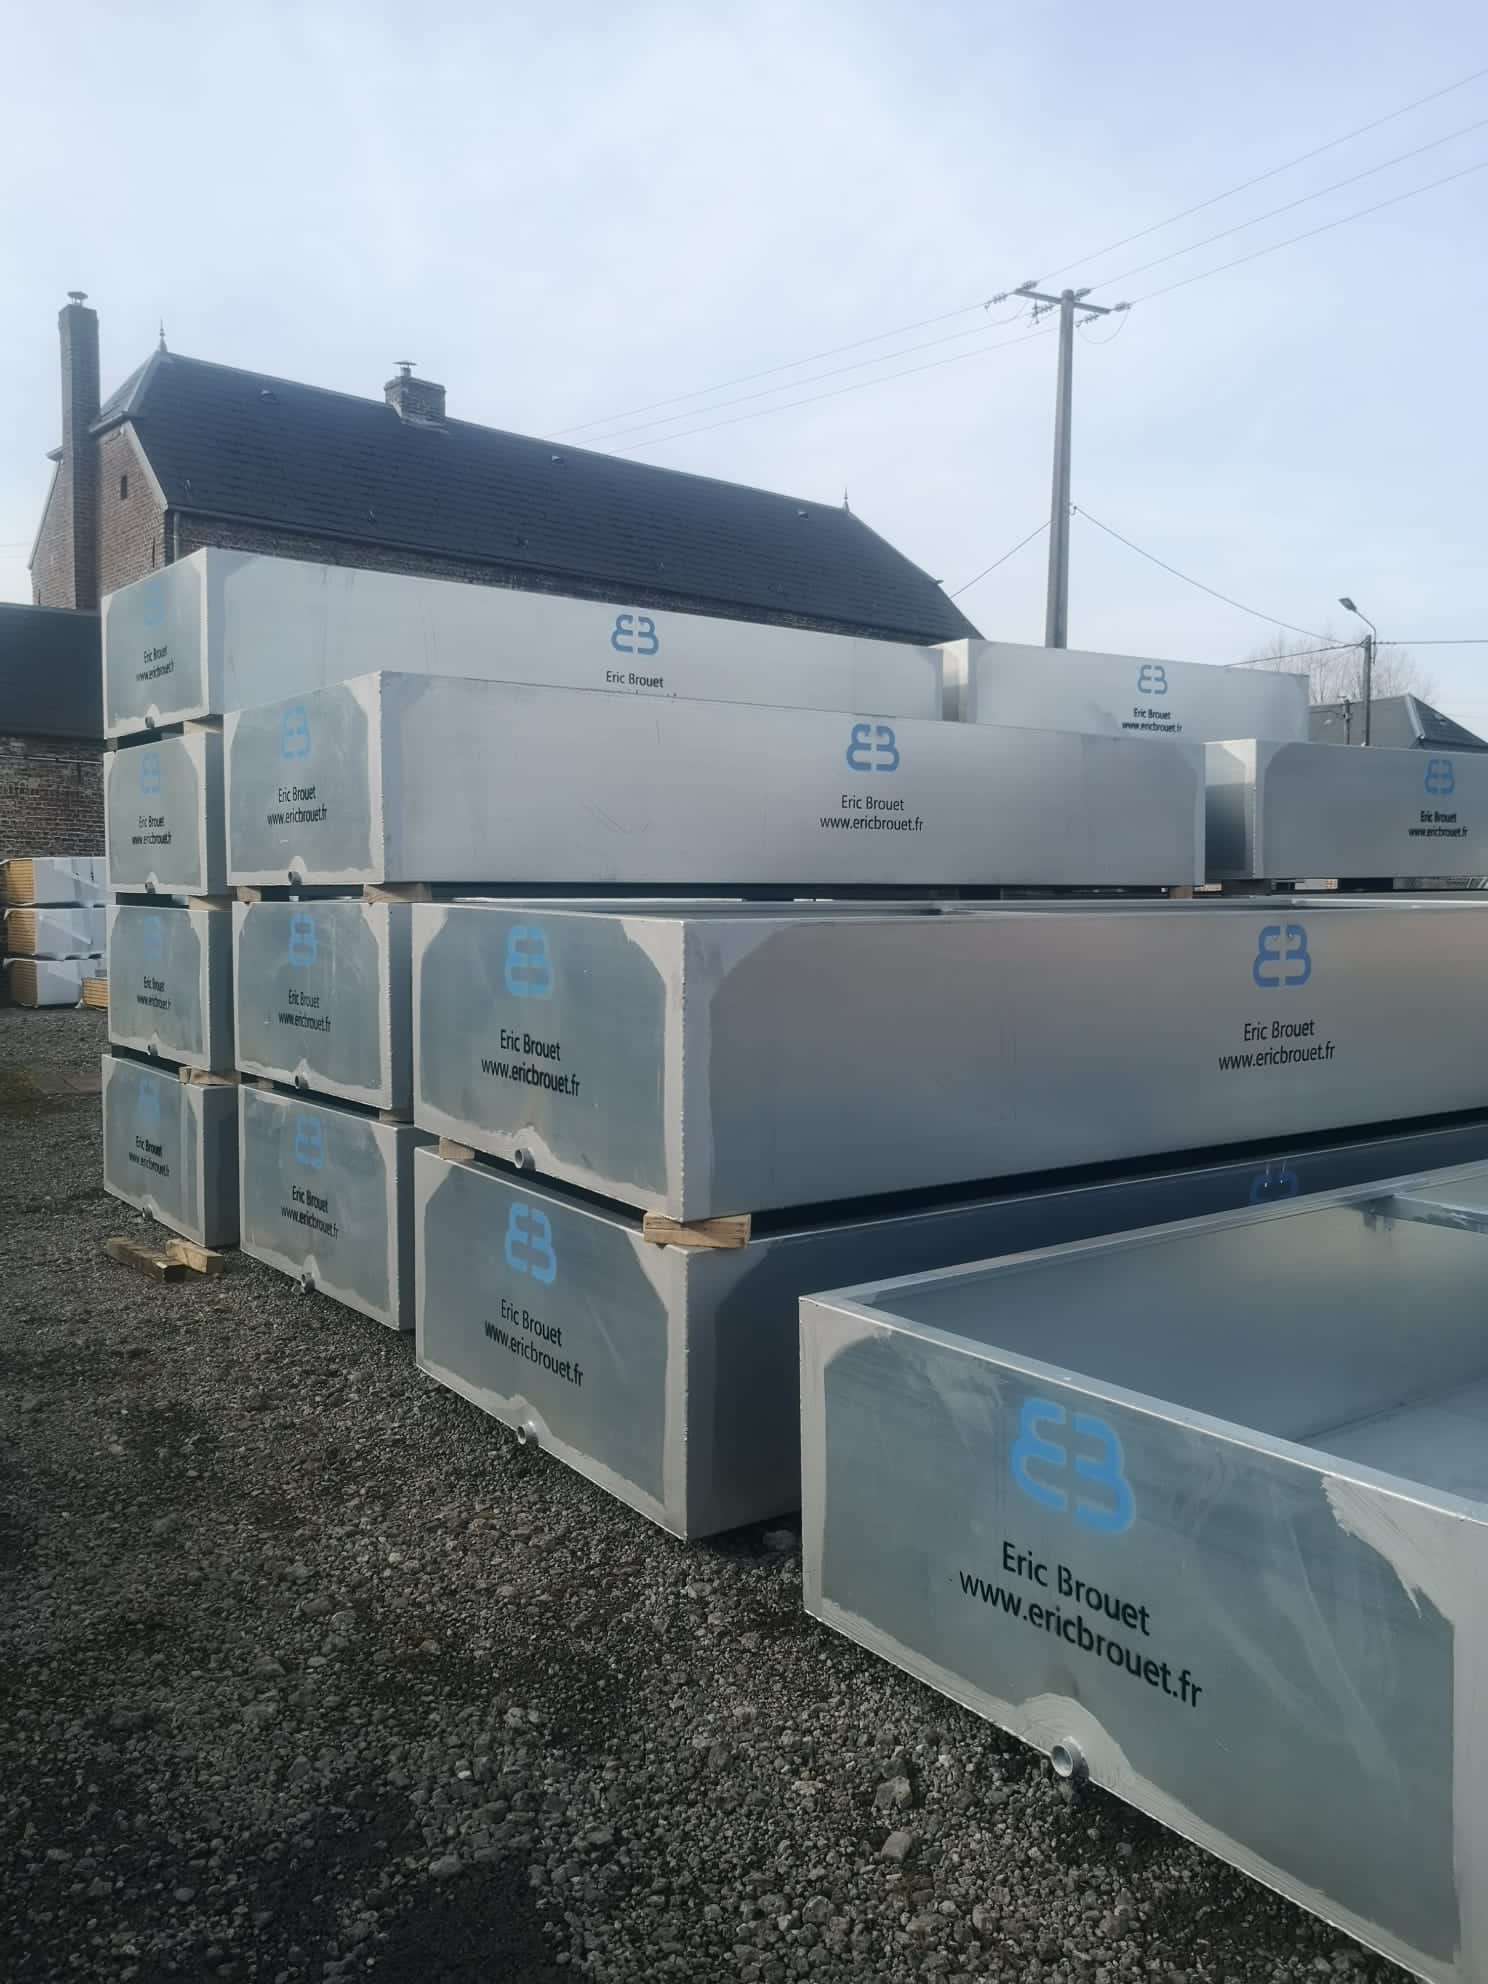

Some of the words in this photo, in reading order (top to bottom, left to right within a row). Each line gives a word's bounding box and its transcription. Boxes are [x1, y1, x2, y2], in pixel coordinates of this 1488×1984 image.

[143, 649, 153, 664] Eric
[153, 645, 168, 661] Brouet
[606, 670, 625, 686] Eric
[628, 673, 664, 689] Brouet
[1133, 707, 1147, 719] Eric
[1148, 708, 1171, 720] Brouet
[1122, 719, 1182, 734] www.ericbrouet.fr
[278, 787, 291, 803] Eric
[292, 784, 316, 801] Brouet
[841, 795, 863, 810] Eric
[865, 796, 905, 812] Brouet
[148, 814, 165, 828] Brouet
[267, 804, 327, 825] www.ericbrouet.fr
[820, 816, 924, 832] www.ericbrouet.fr
[1420, 811, 1433, 823] Eric
[1434, 811, 1457, 824] Brouet
[1408, 825, 1468, 838] www.ericbrouet.fr
[288, 989, 300, 1004] Eric
[301, 991, 320, 1009] Brouet
[278, 1011, 331, 1033] www.ericbrouet.fr
[1244, 1022, 1268, 1042] Eric
[1272, 1018, 1315, 1039] Brouet
[500, 1028, 520, 1053] Eric
[523, 1034, 561, 1062] Brouet
[1218, 1041, 1335, 1071] www.ericbrouet.fr
[481, 1056, 580, 1098] www.ericbrouet.fr
[135, 1135, 146, 1151] Eric
[292, 1185, 306, 1204] Eric
[307, 1193, 329, 1213] Brouet
[281, 1204, 339, 1240] www.ericbrouet.fr
[500, 1298, 520, 1325] Eric
[522, 1309, 562, 1348] Brouet
[485, 1319, 584, 1387] www.ericbrouet.fr
[1002, 1541, 1048, 1587] Eric
[1058, 1565, 1151, 1636] Brouet
[959, 1570, 1202, 1707] www.ericbrouet.fr
